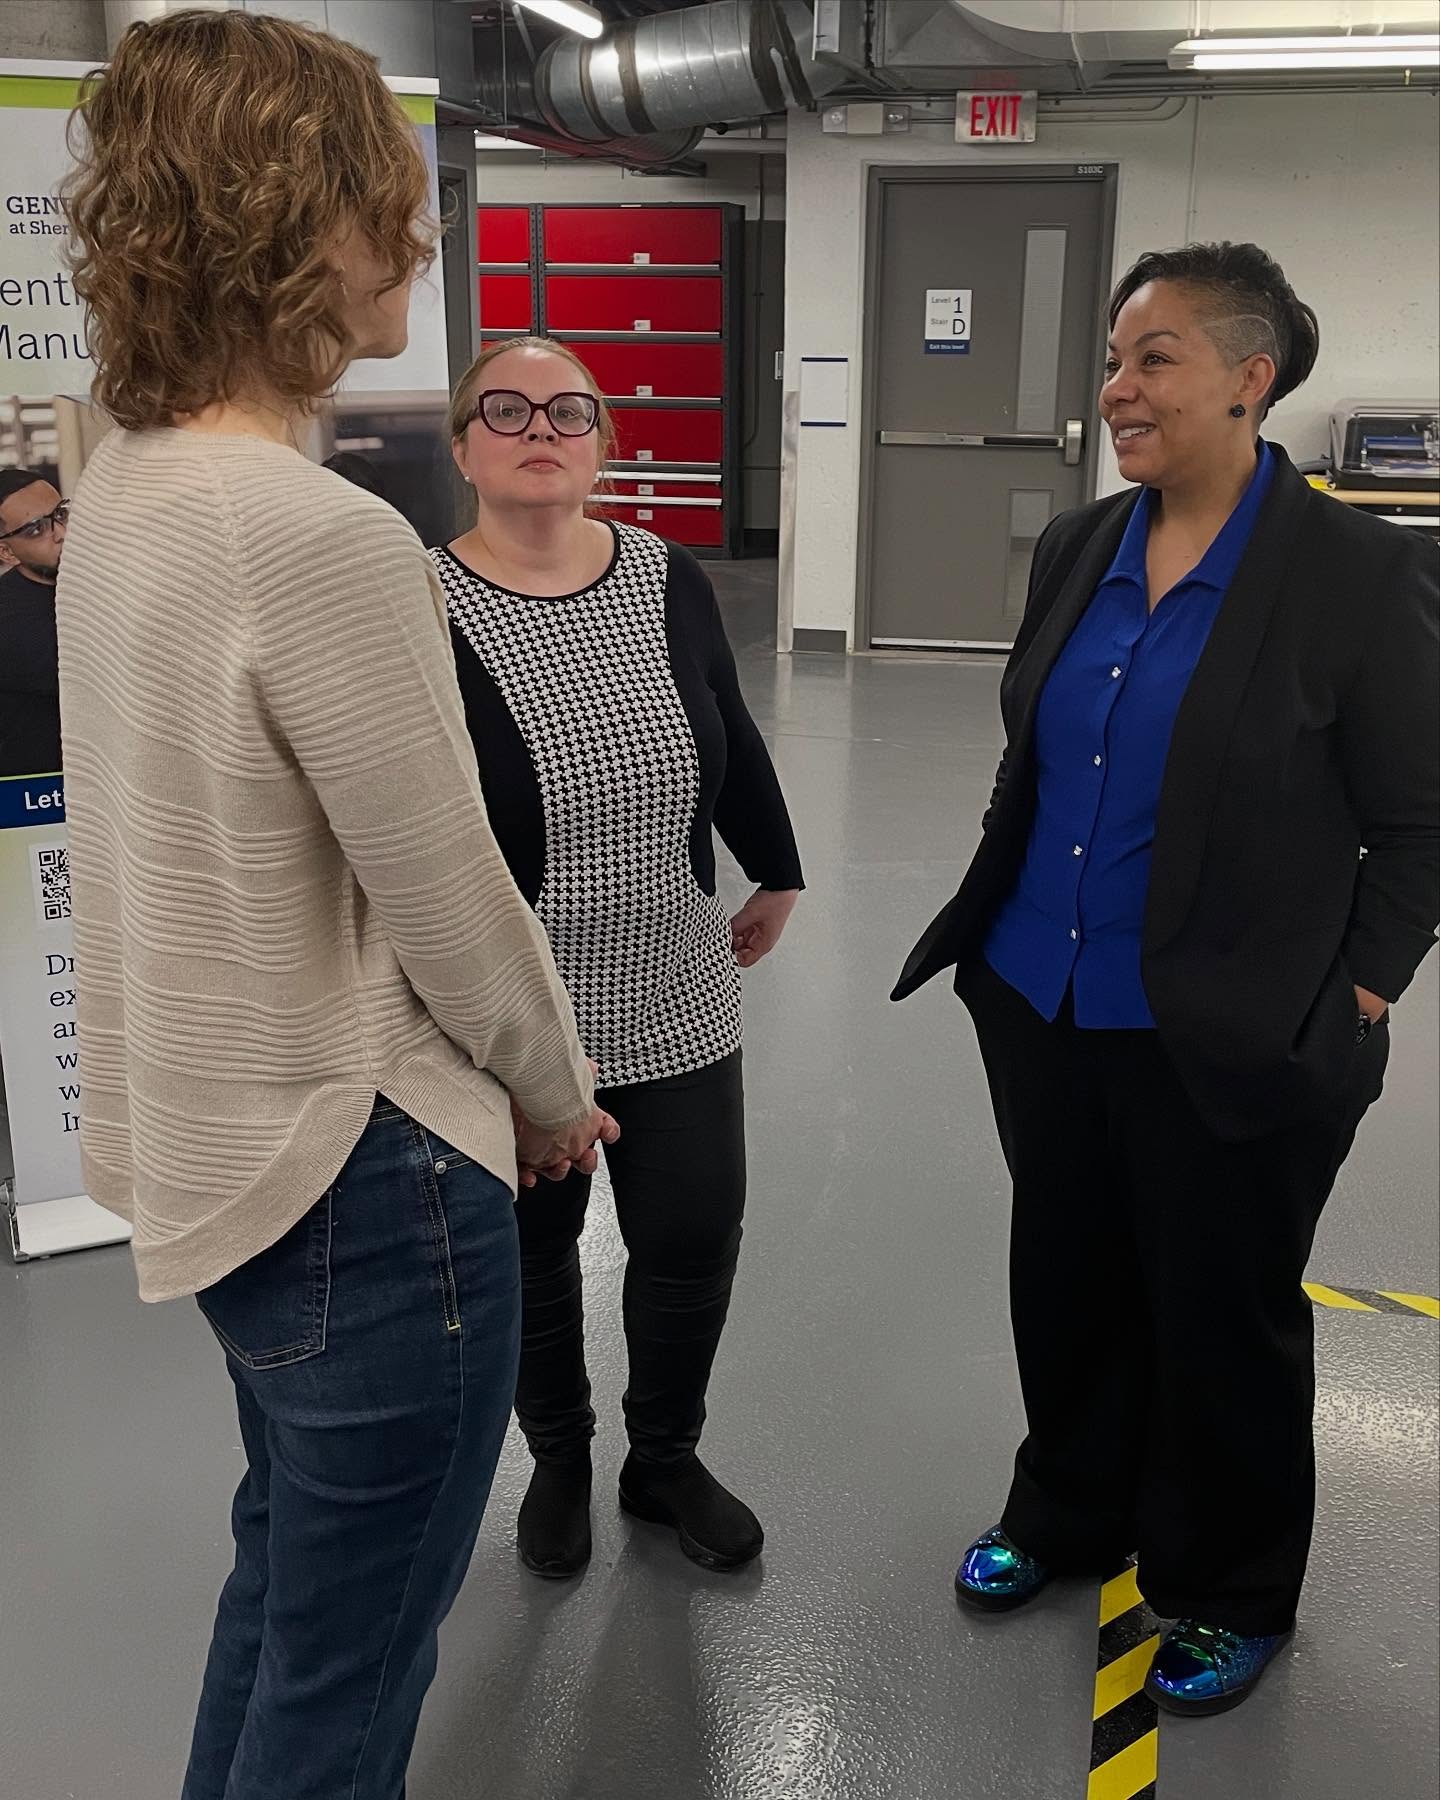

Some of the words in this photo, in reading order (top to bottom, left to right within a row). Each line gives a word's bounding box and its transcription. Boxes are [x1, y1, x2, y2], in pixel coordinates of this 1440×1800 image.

[970, 95, 1022, 137] EXIT
[9, 222, 26, 234] at
[954, 297, 963, 313] 1
[953, 319, 965, 334] D
[25, 789, 64, 810] Let
